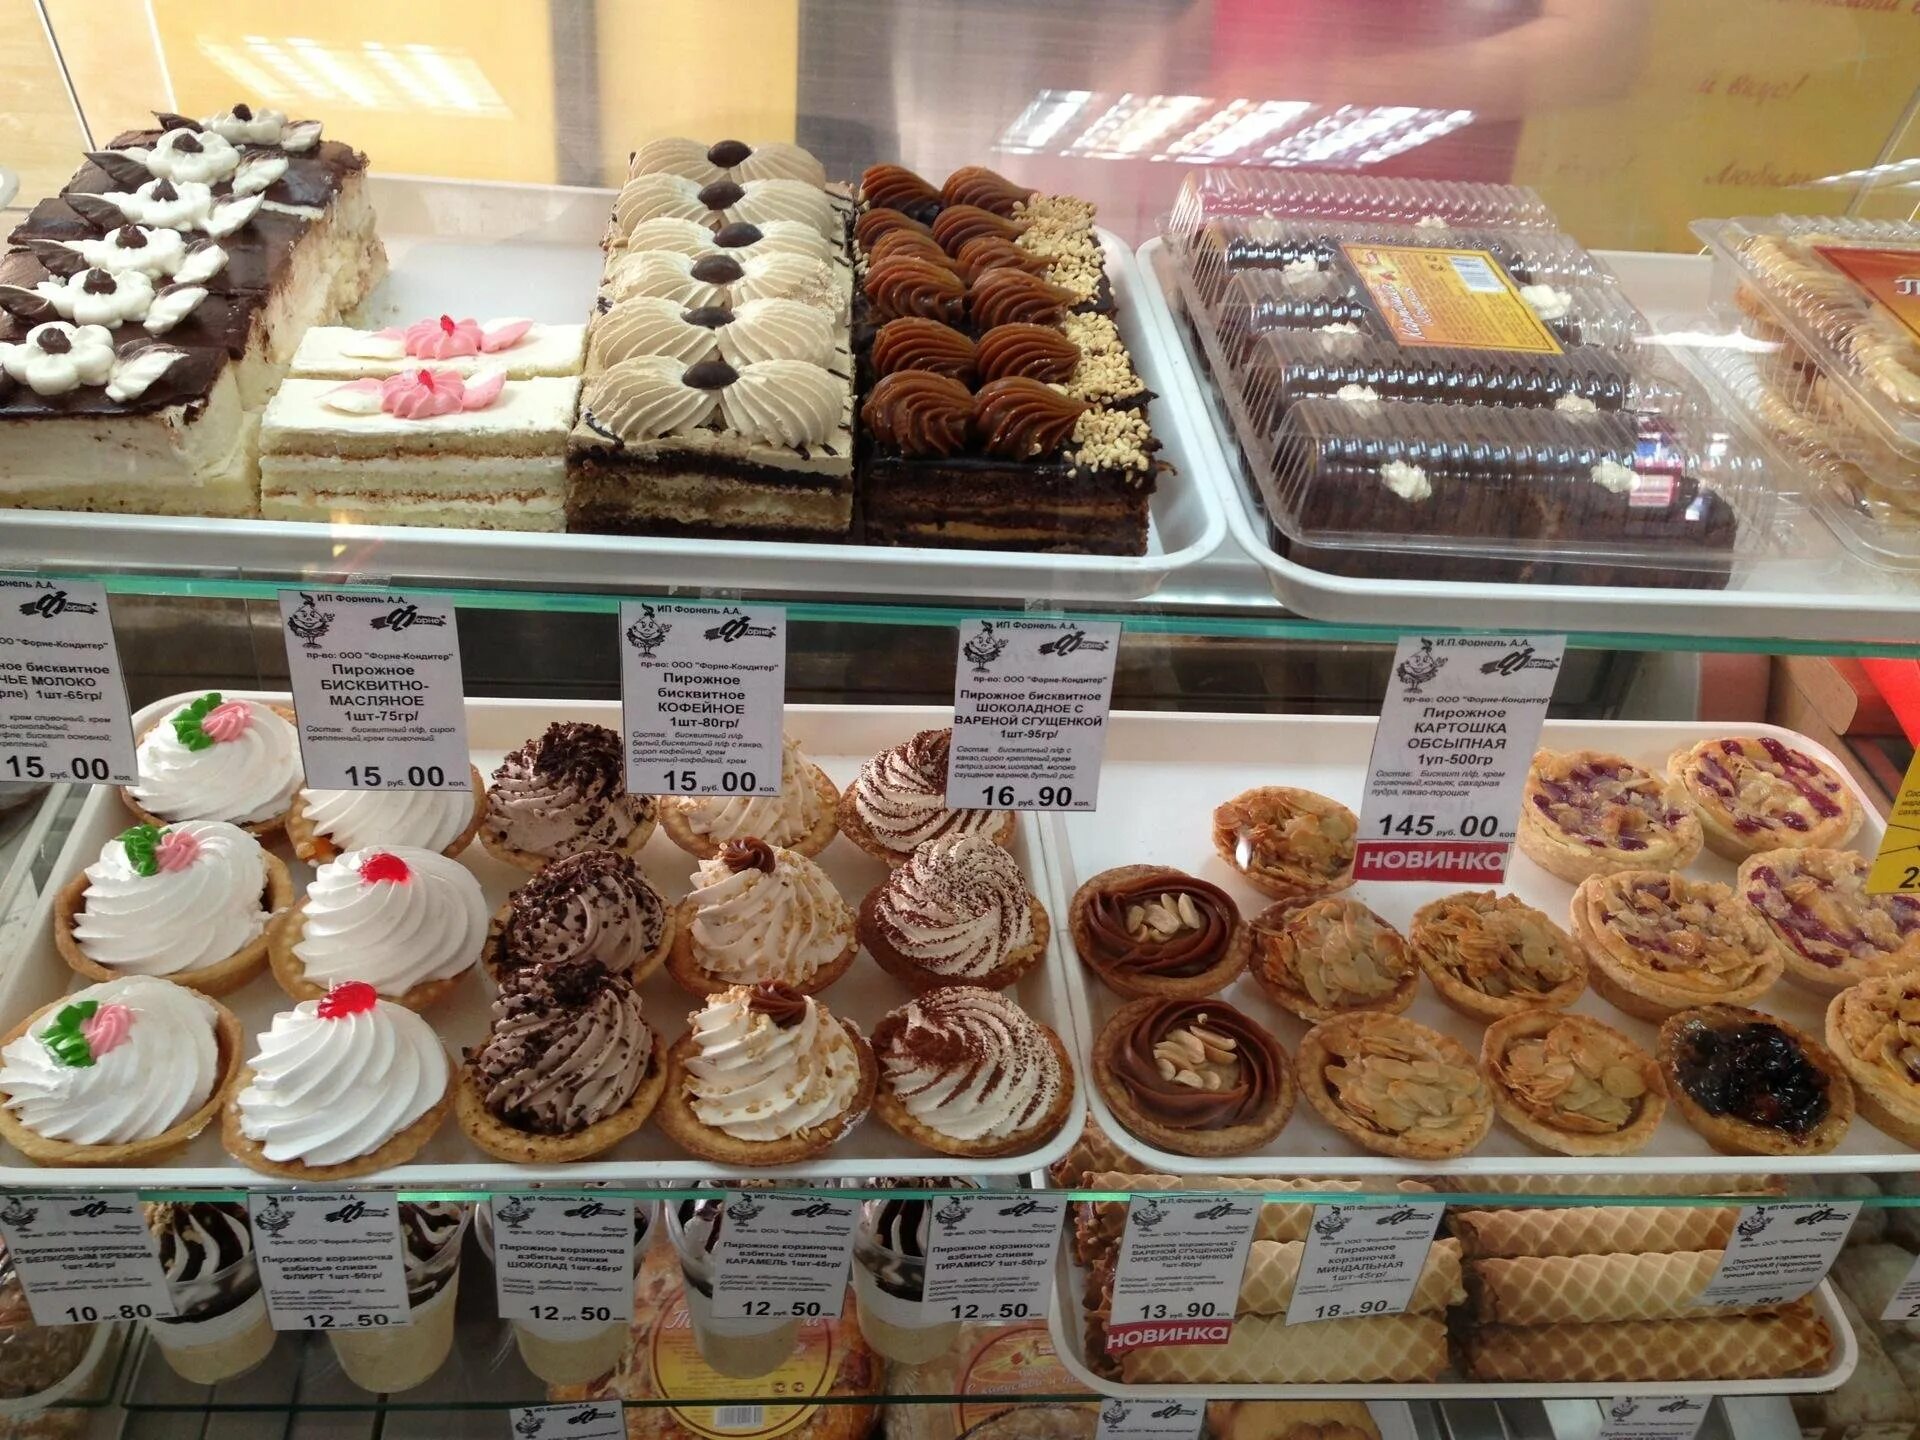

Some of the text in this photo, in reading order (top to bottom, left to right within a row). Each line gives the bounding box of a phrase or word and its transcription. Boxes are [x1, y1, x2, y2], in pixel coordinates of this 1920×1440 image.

[317, 594, 332, 602] ИП
[387, 596, 407, 604] А.А.
[657, 605, 671, 613] ИП
[723, 607, 742, 615] А.А.
[1059, 622, 1078, 630] А.А.
[1509, 639, 1531, 647] А.А.
[27, 662, 110, 674] бисквитное
[332, 664, 415, 676] Пирожное
[32, 676, 96, 687] МОЛОКО
[663, 673, 740, 685] Пирожное
[321, 680, 429, 691] БИСКВИТНО-
[657, 688, 745, 699] бисквитное
[960, 690, 1101, 701] Пирожное бисквитное
[330, 695, 424, 706] МАСЛЯНОЕ
[658, 702, 745, 714] КОФЕЙНОЕ
[976, 704, 1084, 714] ШОКОЛАДНОЕ С
[1423, 708, 1506, 719] Пирожное
[344, 711, 419, 722] 1шт-75гр/
[954, 715, 1102, 727] ВАРЕНОЙ СГУЩЕНКОЙ
[670, 717, 739, 729] 1шт-80гр/
[1414, 723, 1507, 733] КАРТОШКА
[1000, 730, 1059, 739] 1шт-95гр/
[1408, 738, 1507, 749] ОБСЫПНАЯ
[1418, 754, 1493, 766] 1уп-500гр
[7, 755, 44, 778] 15
[72, 757, 109, 780] 00
[345, 766, 382, 786] 15
[387, 779, 406, 787] руб.
[408, 766, 444, 787] 00
[663, 770, 697, 791] 15
[722, 771, 756, 792] 00
[982, 785, 1015, 806] 16
[1038, 786, 1072, 806] 90
[1379, 814, 1499, 837] 145 руб. 00
[500, 1244, 557, 1252] Пирожное
[932, 1244, 987, 1253] Пирожное
[1132, 1248, 1176, 1256] ВАРЕНОЙ
[1335, 1244, 1396, 1255] Пирожное
[262, 1255, 393, 1264] Пирожное корзиночка
[726, 1258, 787, 1266] КАРАМЕЛЬ
[1130, 1255, 1181, 1263] ОРЕХОВОЙ
[1328, 1254, 1396, 1265] корзиночка
[507, 1262, 568, 1270] ШОКОЛАД
[935, 1261, 995, 1270] ТИРАМИСУ
[1316, 1261, 1404, 1275] МИНДАЛЬНАЯ
[66, 1304, 152, 1322] 10 80
[530, 1306, 610, 1321] 12 50
[742, 1301, 821, 1316] 12 50
[951, 1303, 1028, 1318] 12 50
[1140, 1302, 1216, 1319] 13 90
[1315, 1300, 1388, 1318] 18 90
[304, 1314, 388, 1328] 12 50
